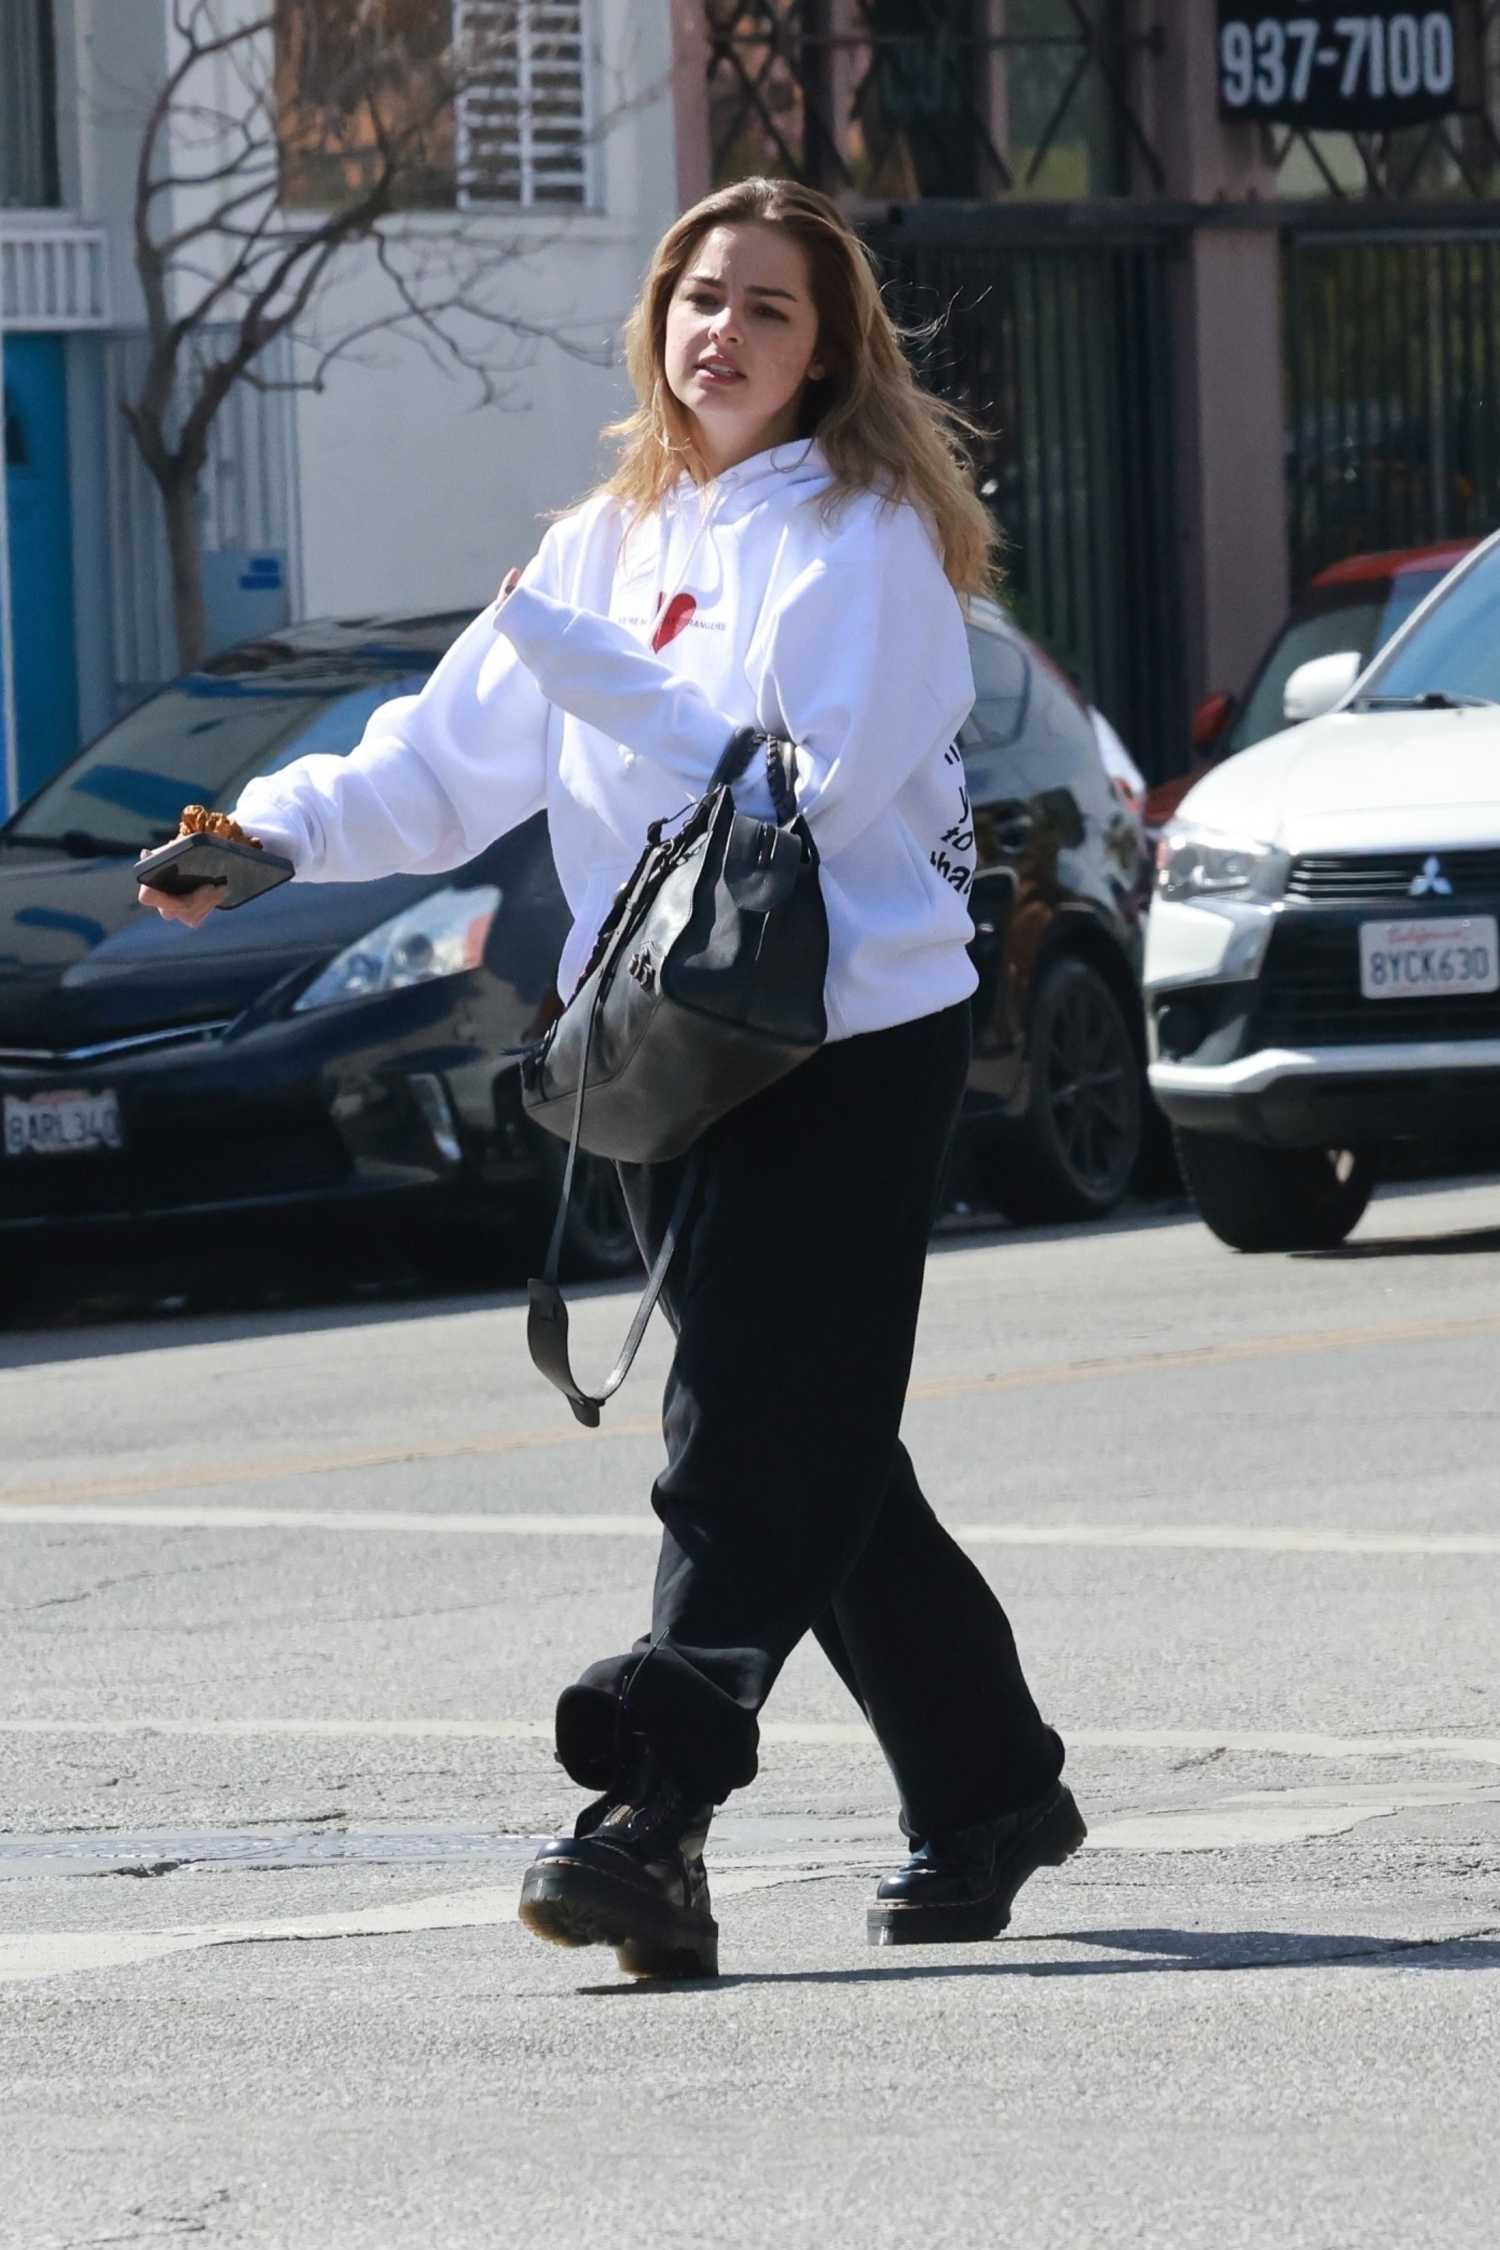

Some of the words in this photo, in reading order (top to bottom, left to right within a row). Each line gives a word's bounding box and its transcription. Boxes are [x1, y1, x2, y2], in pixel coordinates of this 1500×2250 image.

[1221, 12, 1453, 106] 937-7100
[940, 826, 973, 851] to
[1370, 945, 1490, 985] 8YCK630
